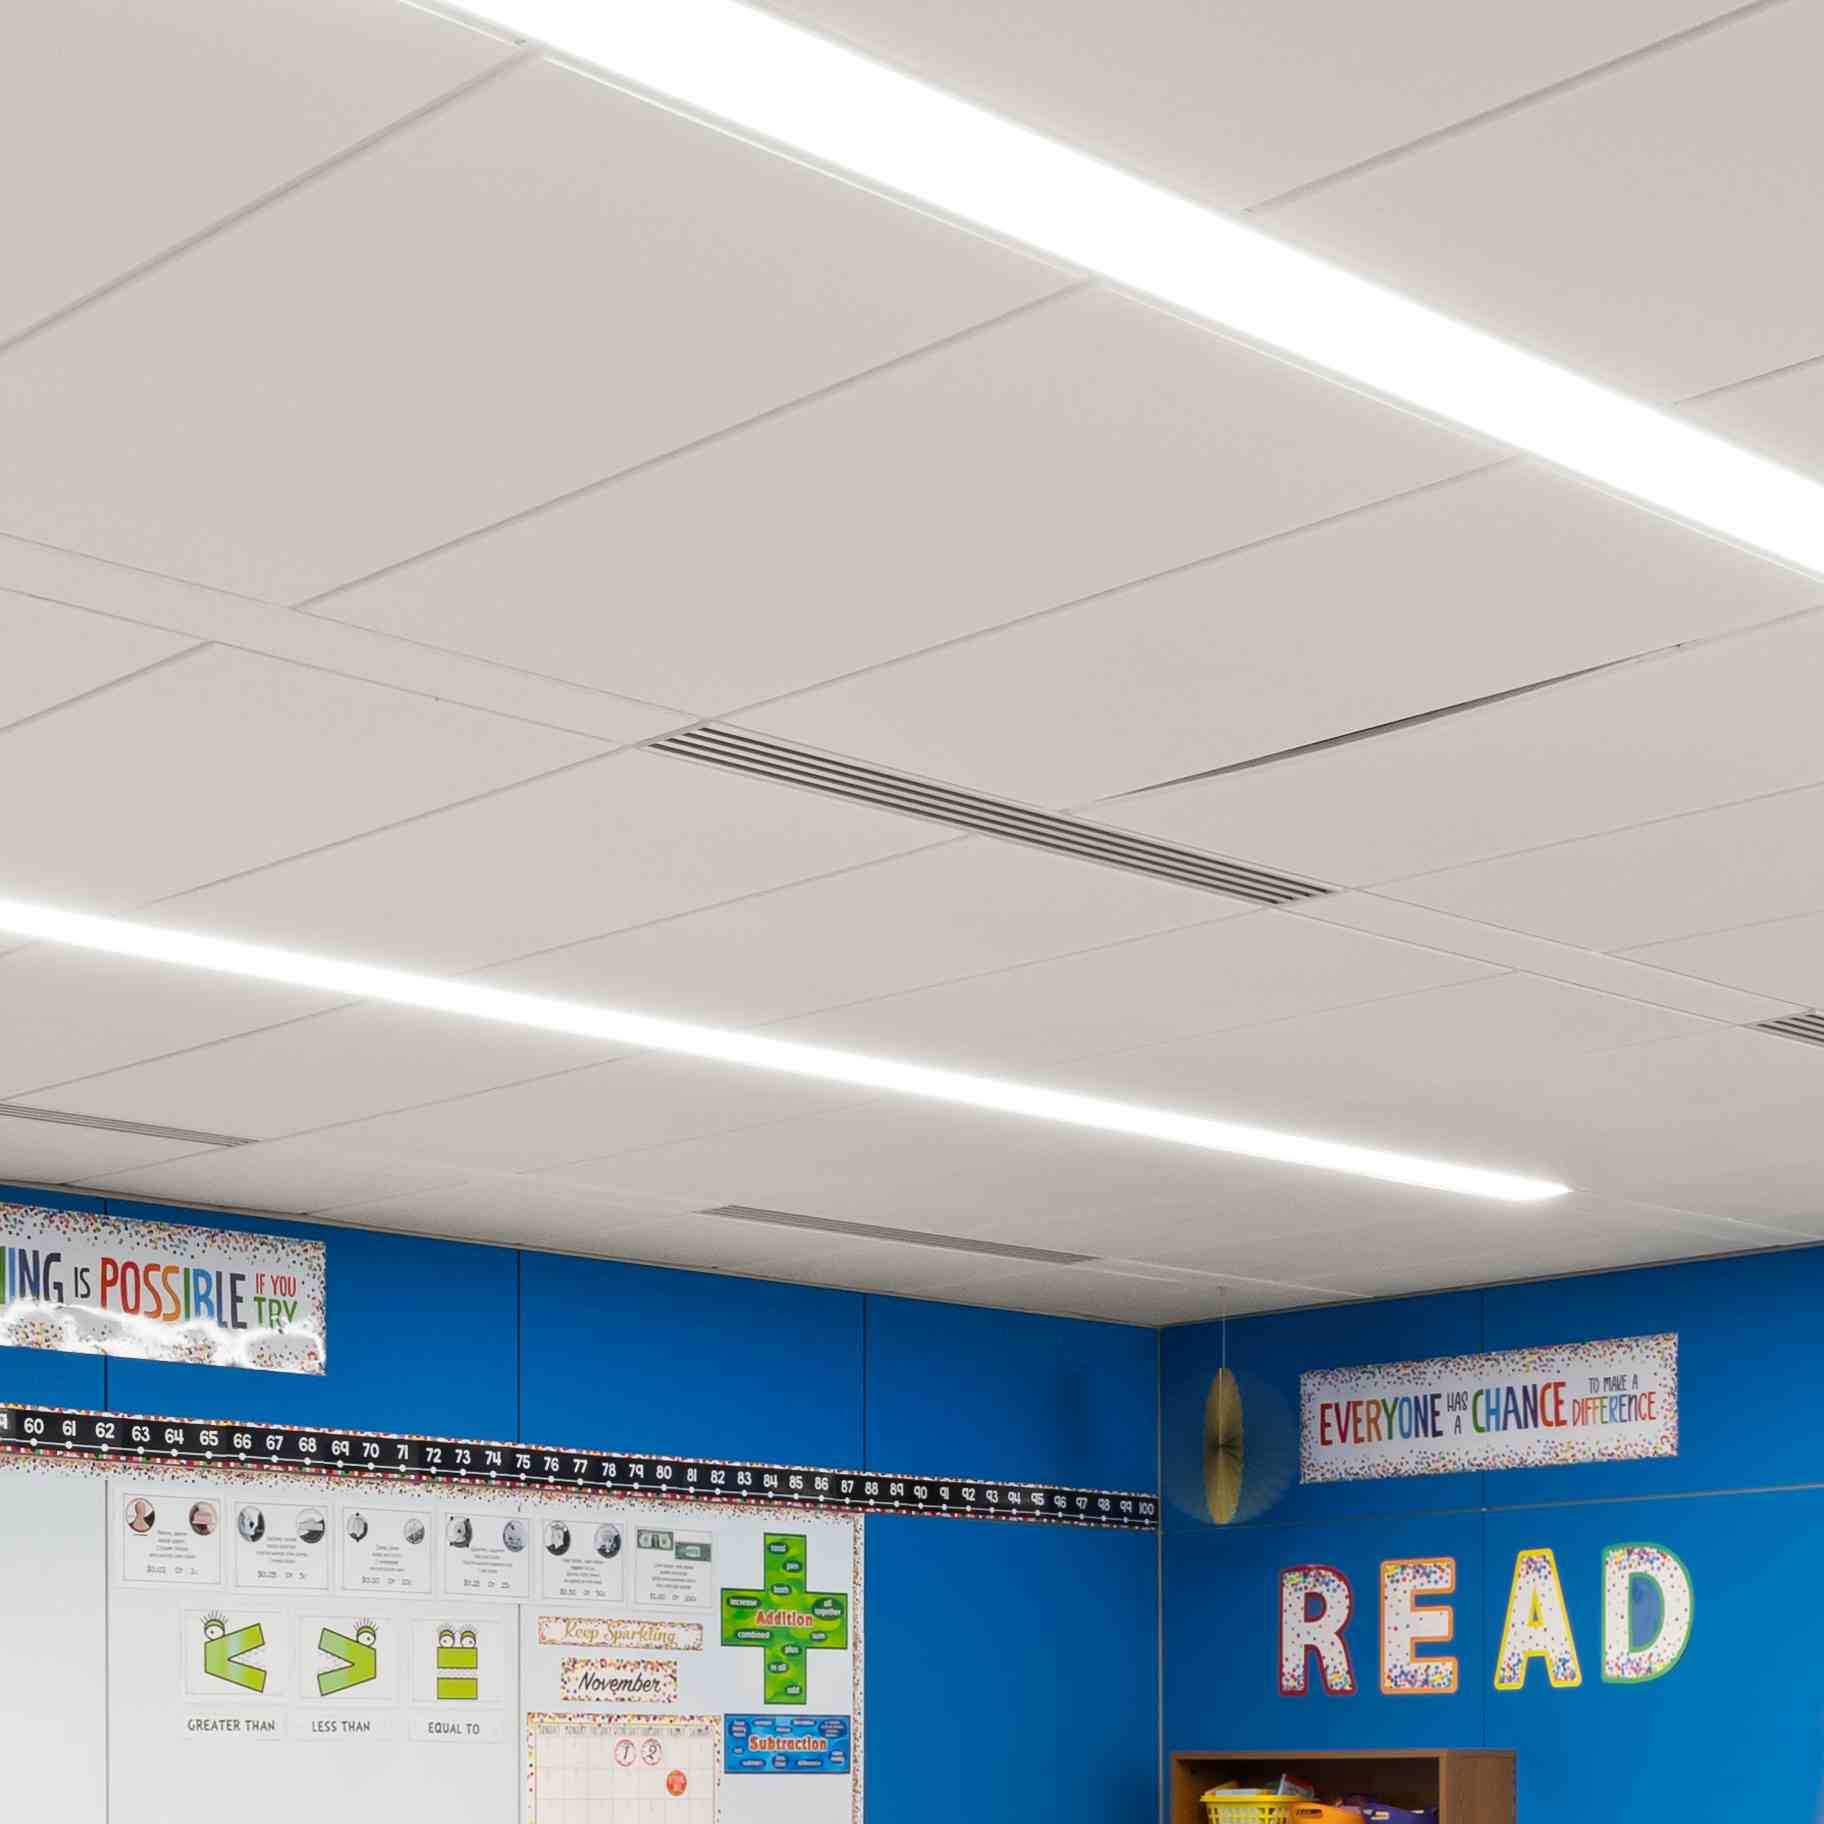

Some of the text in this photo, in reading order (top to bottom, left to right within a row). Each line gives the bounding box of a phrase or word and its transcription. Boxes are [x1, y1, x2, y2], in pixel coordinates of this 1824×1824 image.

[74, 1266, 91, 1299] IS
[100, 1256, 247, 1330] POSSIBLE
[255, 1272, 297, 1298] IF YOU
[253, 1295, 298, 1328] TRY
[1588, 1373, 1639, 1394] TO MAKE A
[1447, 1390, 1469, 1413] HAS
[1472, 1381, 1567, 1433] CHANCE
[1319, 1393, 1443, 1447] EVERYONE
[1454, 1415, 1462, 1435] A
[24, 1418, 44, 1434] 60
[63, 1421, 76, 1436] 61
[96, 1423, 114, 1438] 62
[132, 1426, 150, 1441] 63
[165, 1429, 184, 1444] 64
[200, 1431, 218, 1445] 65
[234, 1434, 251, 1448] 66
[266, 1435, 283, 1450] 67
[299, 1437, 316, 1452] 68
[332, 1441, 349, 1456] 69
[363, 1443, 379, 1457] 70
[397, 1445, 408, 1459] 71
[426, 1448, 441, 1462] 72
[456, 1449, 470, 1464] 73
[485, 1451, 501, 1465] 74
[516, 1454, 530, 1469] 75
[544, 1457, 559, 1471] 76
[574, 1459, 587, 1473] 77
[602, 1463, 616, 1477] 78
[629, 1464, 643, 1478] 79
[656, 1465, 671, 1479] 80
[687, 1468, 696, 1481] 81
[711, 1470, 725, 1484] 82
[738, 1472, 751, 1485] 83
[764, 1474, 778, 1487] 84
[790, 1476, 803, 1489] 85
[815, 1477, 828, 1490] 86
[841, 1480, 853, 1493] 87
[865, 1482, 878, 1495] 88
[890, 1483, 903, 1496] 89
[914, 1486, 927, 1499] 90
[940, 1487, 949, 1499] 91
[1139, 1503, 1154, 1515] 100
[754, 1609, 815, 1628] Addition
[1277, 1541, 1694, 1696] READ
[563, 1620, 676, 1648] Keep Sparkling
[578, 1671, 662, 1694] November
[187, 1719, 276, 1733] GREATER THAN
[311, 1720, 371, 1733] LESS THAN
[427, 1721, 480, 1735] EQUAL TO
[749, 1735, 828, 1751] Subtraction
